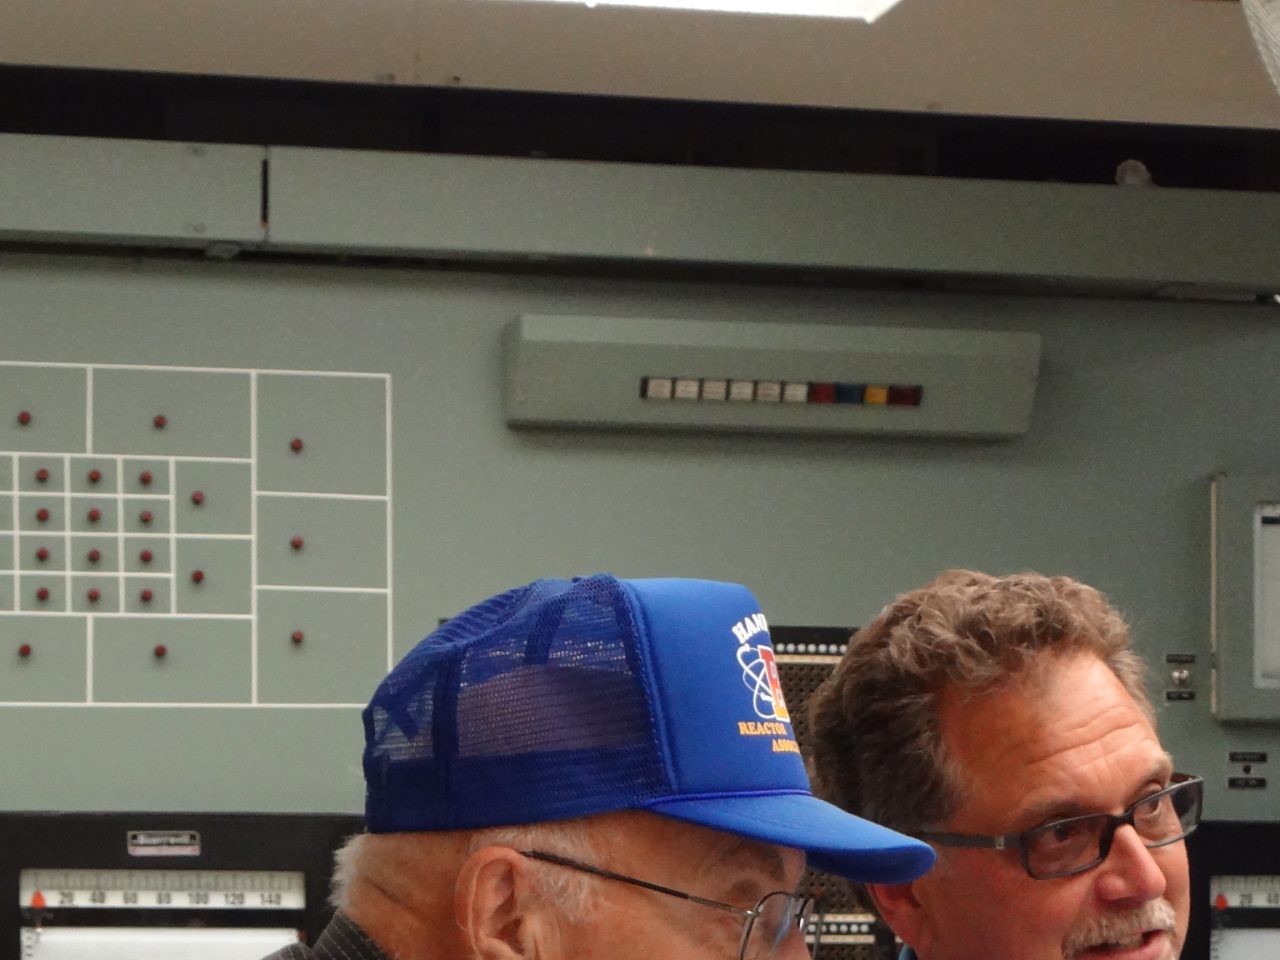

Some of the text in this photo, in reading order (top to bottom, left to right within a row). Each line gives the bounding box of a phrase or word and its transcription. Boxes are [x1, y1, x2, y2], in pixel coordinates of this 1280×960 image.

[59, 893, 74, 905] 20
[89, 893, 106, 905] 40
[187, 893, 209, 905] 100
[223, 893, 245, 905] 120
[259, 893, 281, 905] 140
[1240, 894, 1253, 906] 20
[1266, 894, 1280, 906] 40
